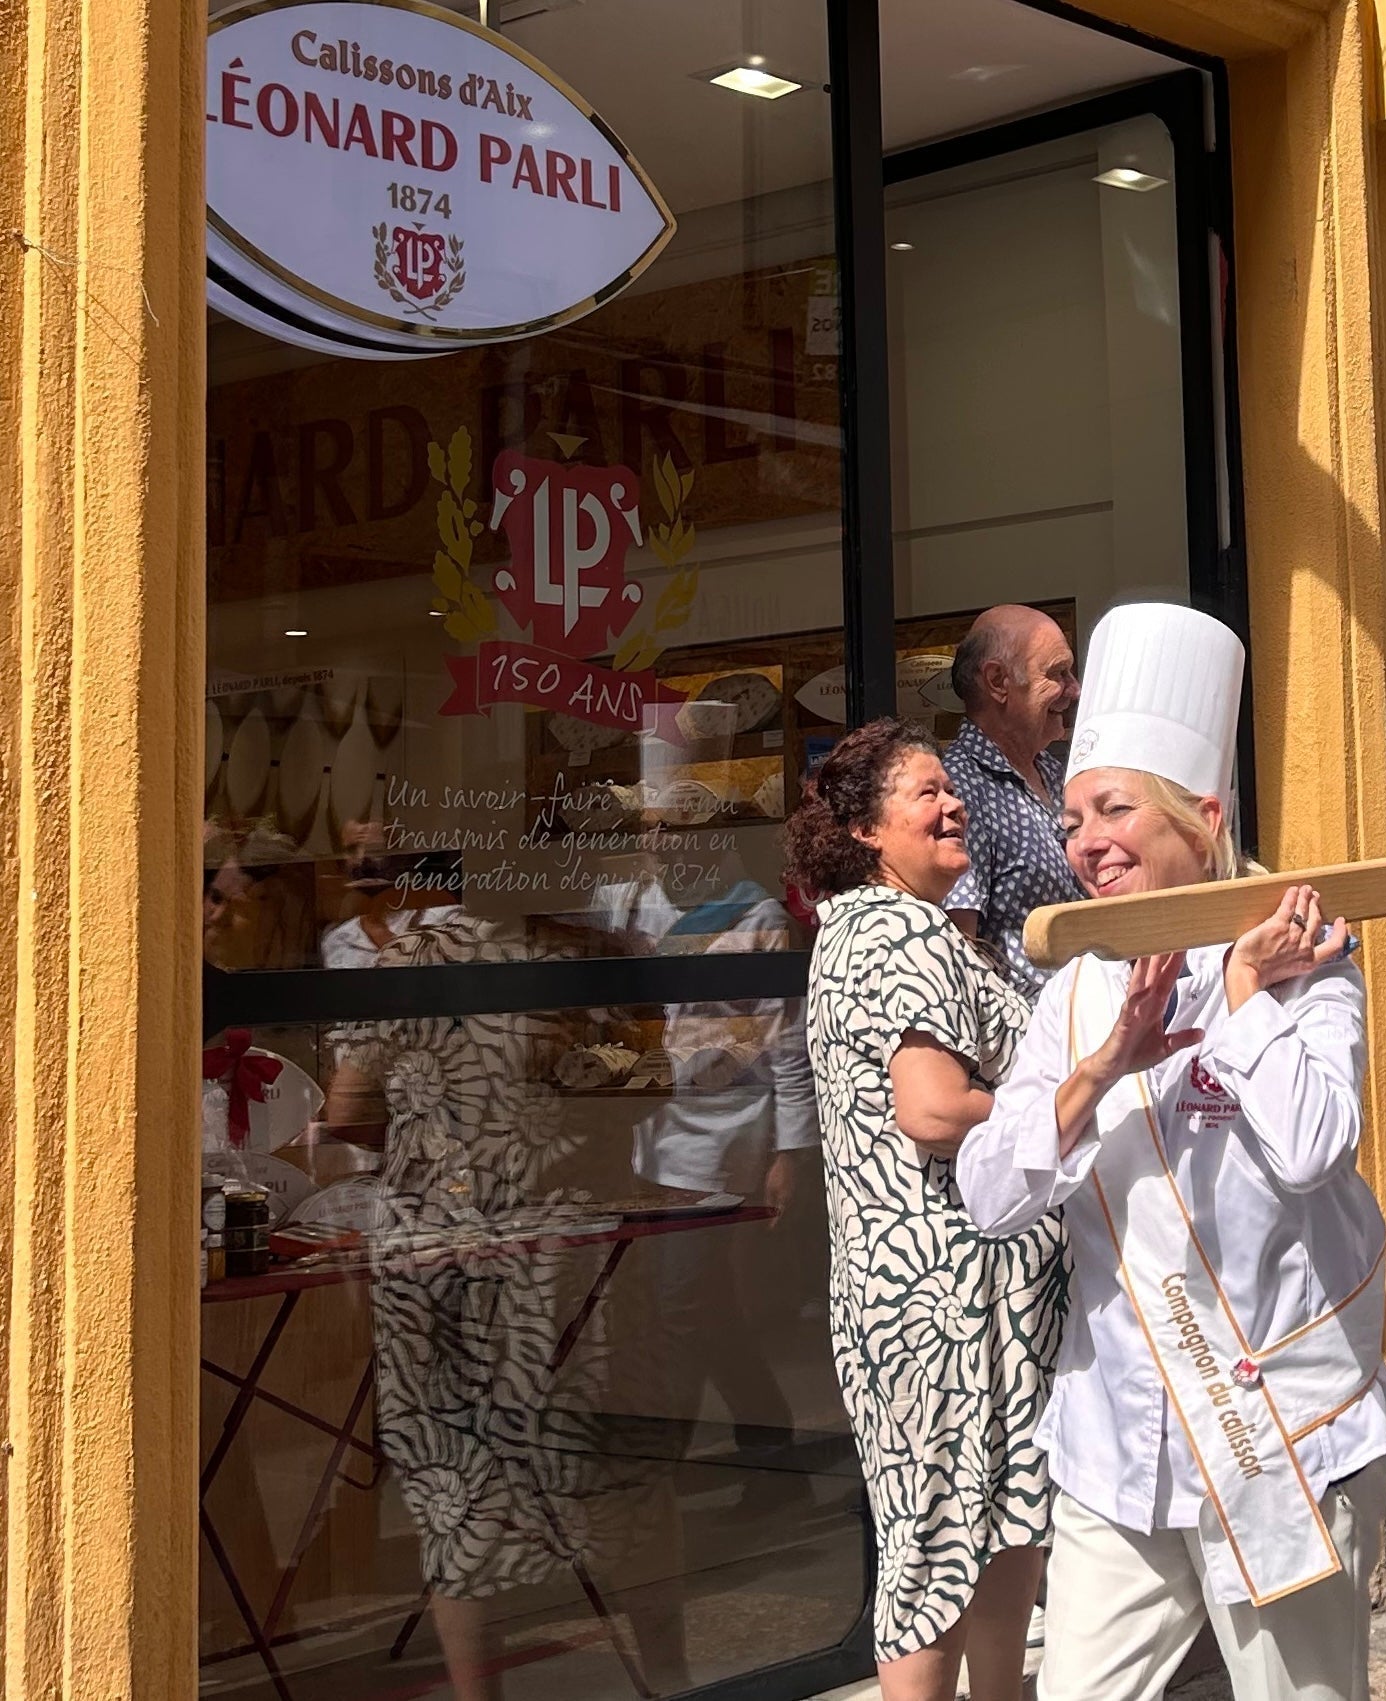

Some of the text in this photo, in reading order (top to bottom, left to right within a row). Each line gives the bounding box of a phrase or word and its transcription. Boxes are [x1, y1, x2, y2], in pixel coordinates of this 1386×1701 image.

[291, 29, 533, 121] Calissons d'Aix
[386, 181, 452, 220] 1874
[479, 132, 621, 213] PARLI
[404, 235, 436, 290] LP
[532, 474, 612, 639] LP
[489, 653, 644, 725] 150 ANS
[387, 774, 431, 809] Un
[440, 770, 613, 828] savoir-faire
[382, 813, 739, 868] transmis de génération en
[386, 855, 552, 910] génération
[1161, 1271, 1264, 1481] Compagnon du calisson
